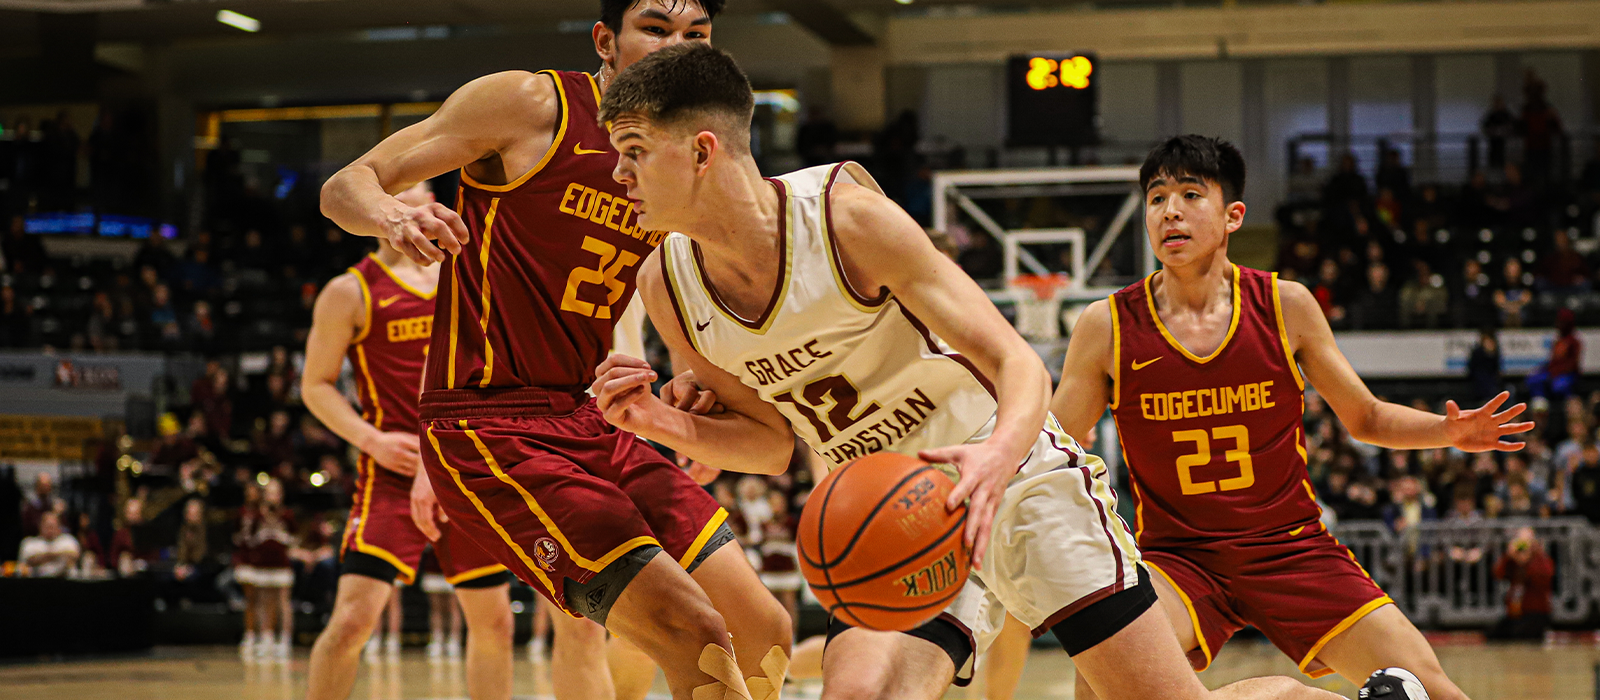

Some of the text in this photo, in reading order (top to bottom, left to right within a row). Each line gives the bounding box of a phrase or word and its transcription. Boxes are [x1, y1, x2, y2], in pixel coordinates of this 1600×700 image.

[559, 182, 669, 248] EDGEC
[560, 235, 640, 319] 25
[745, 339, 832, 386] GRACE
[771, 371, 882, 445] 12
[1140, 380, 1275, 421] EDGECUMBE
[1172, 424, 1255, 495] 23
[902, 551, 958, 597] ROCK
